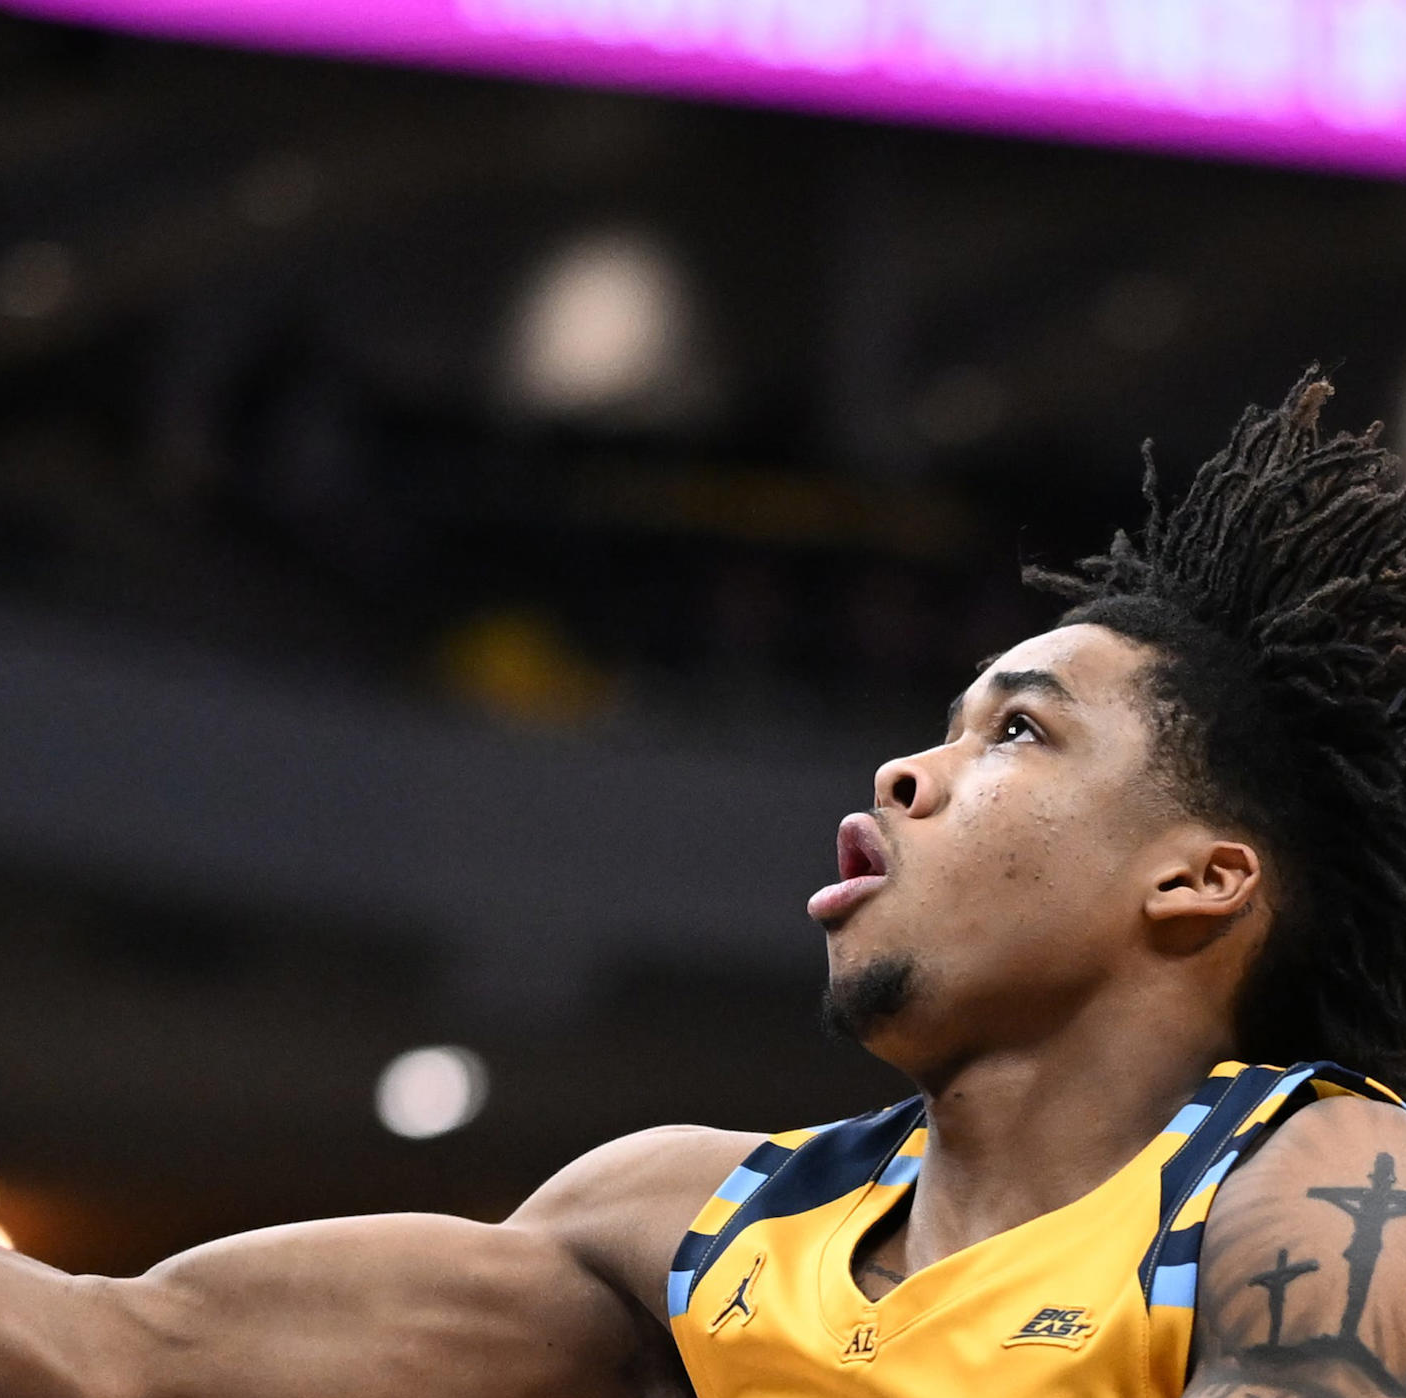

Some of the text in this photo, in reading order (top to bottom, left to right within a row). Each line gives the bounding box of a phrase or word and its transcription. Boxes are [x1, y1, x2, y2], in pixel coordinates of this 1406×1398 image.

[1033, 1307, 1085, 1323] BIG
[1020, 1321, 1091, 1336] EAST
[844, 1328, 874, 1354] AL
